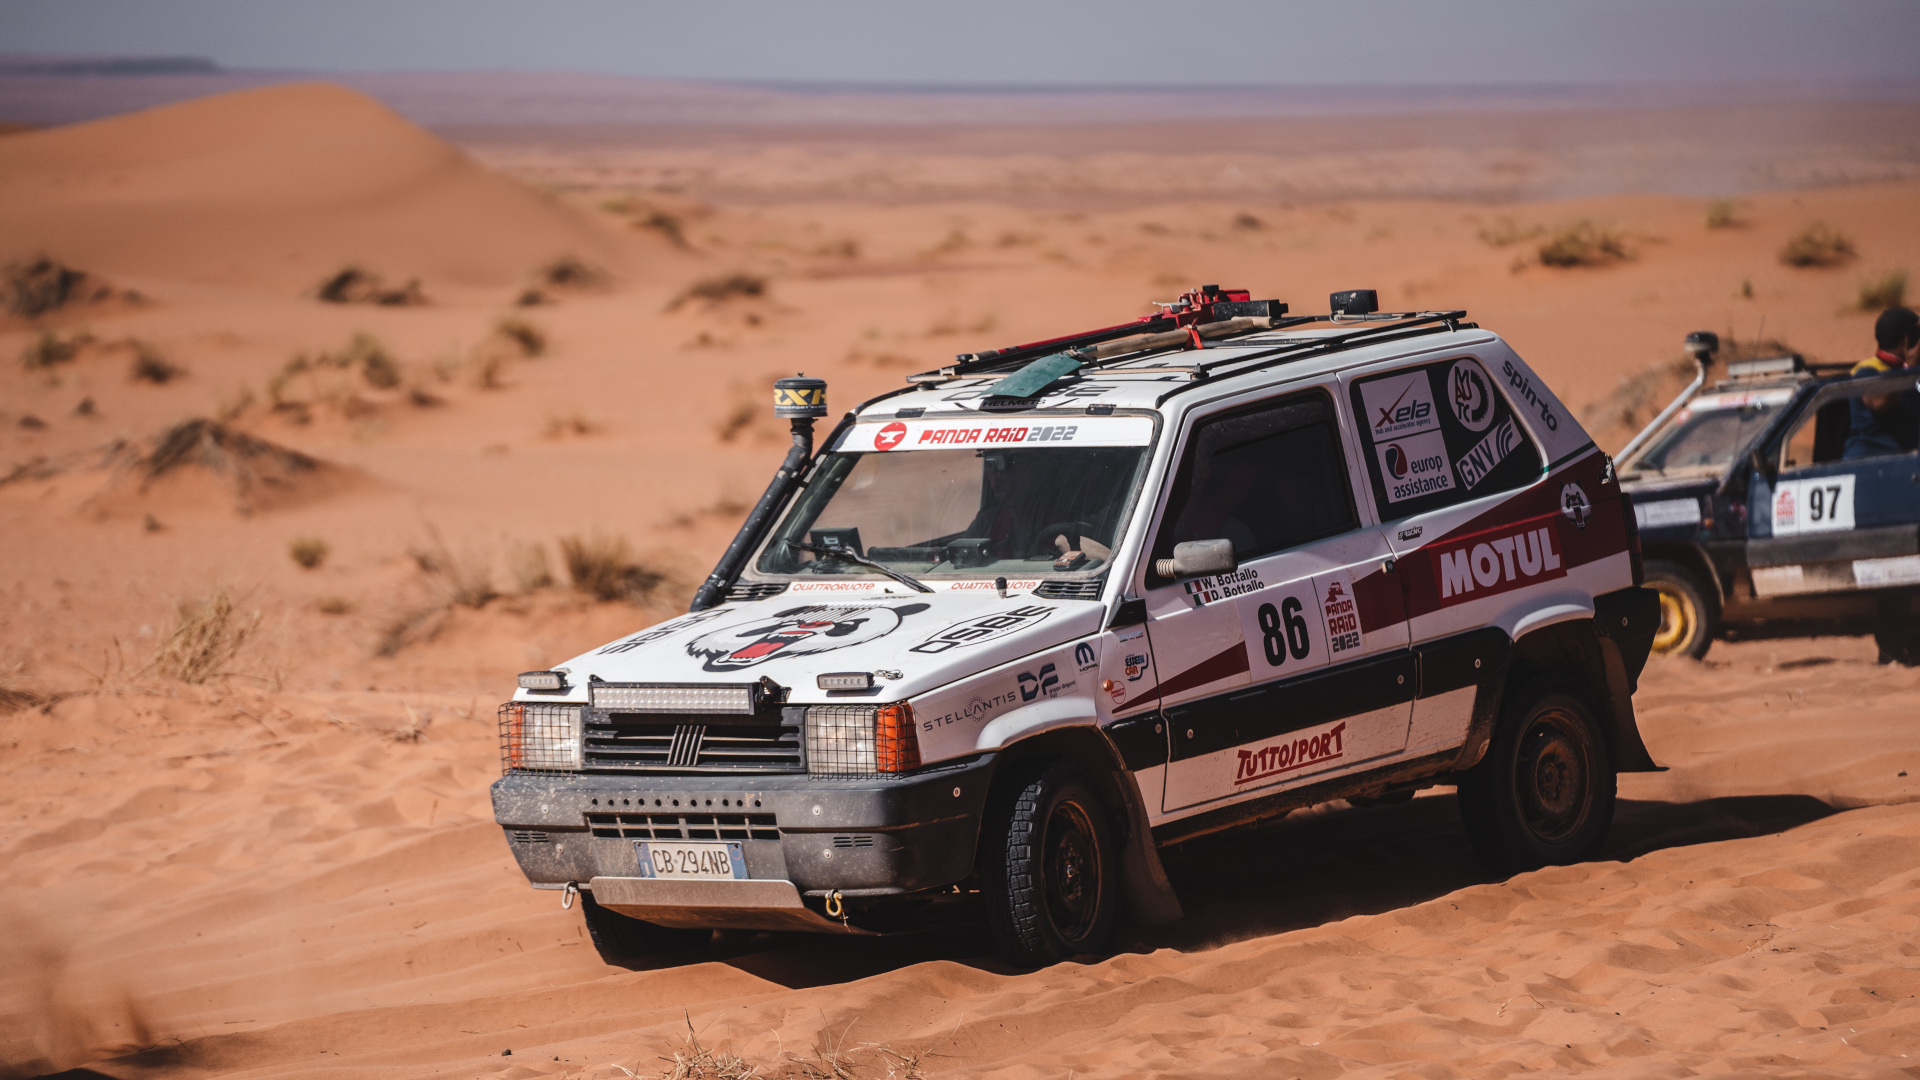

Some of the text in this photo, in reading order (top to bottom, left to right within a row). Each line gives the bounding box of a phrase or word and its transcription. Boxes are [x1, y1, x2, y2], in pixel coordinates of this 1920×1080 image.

[982, 398, 1046, 407] HELMETS
[917, 428, 982, 445] PANDA
[1026, 426, 1079, 442] 2022
[1385, 424, 1393, 432] and
[1416, 418, 1431, 427] agency
[1411, 455, 1443, 474] europ
[1459, 438, 1495, 487] GNV
[1393, 475, 1449, 499] assistance
[1810, 485, 1842, 521] 97
[1440, 527, 1561, 599] MOTUL
[1201, 568, 1258, 590] W. Bottallo
[1210, 580, 1265, 601] D. Bottallo
[1325, 599, 1353, 618] PANDA
[909, 605, 1059, 653] OSBE
[1257, 596, 1311, 667] 86
[1331, 631, 1361, 653] 2022
[1125, 666, 1139, 676] CAR
[923, 691, 1017, 732] STELLANTIS
